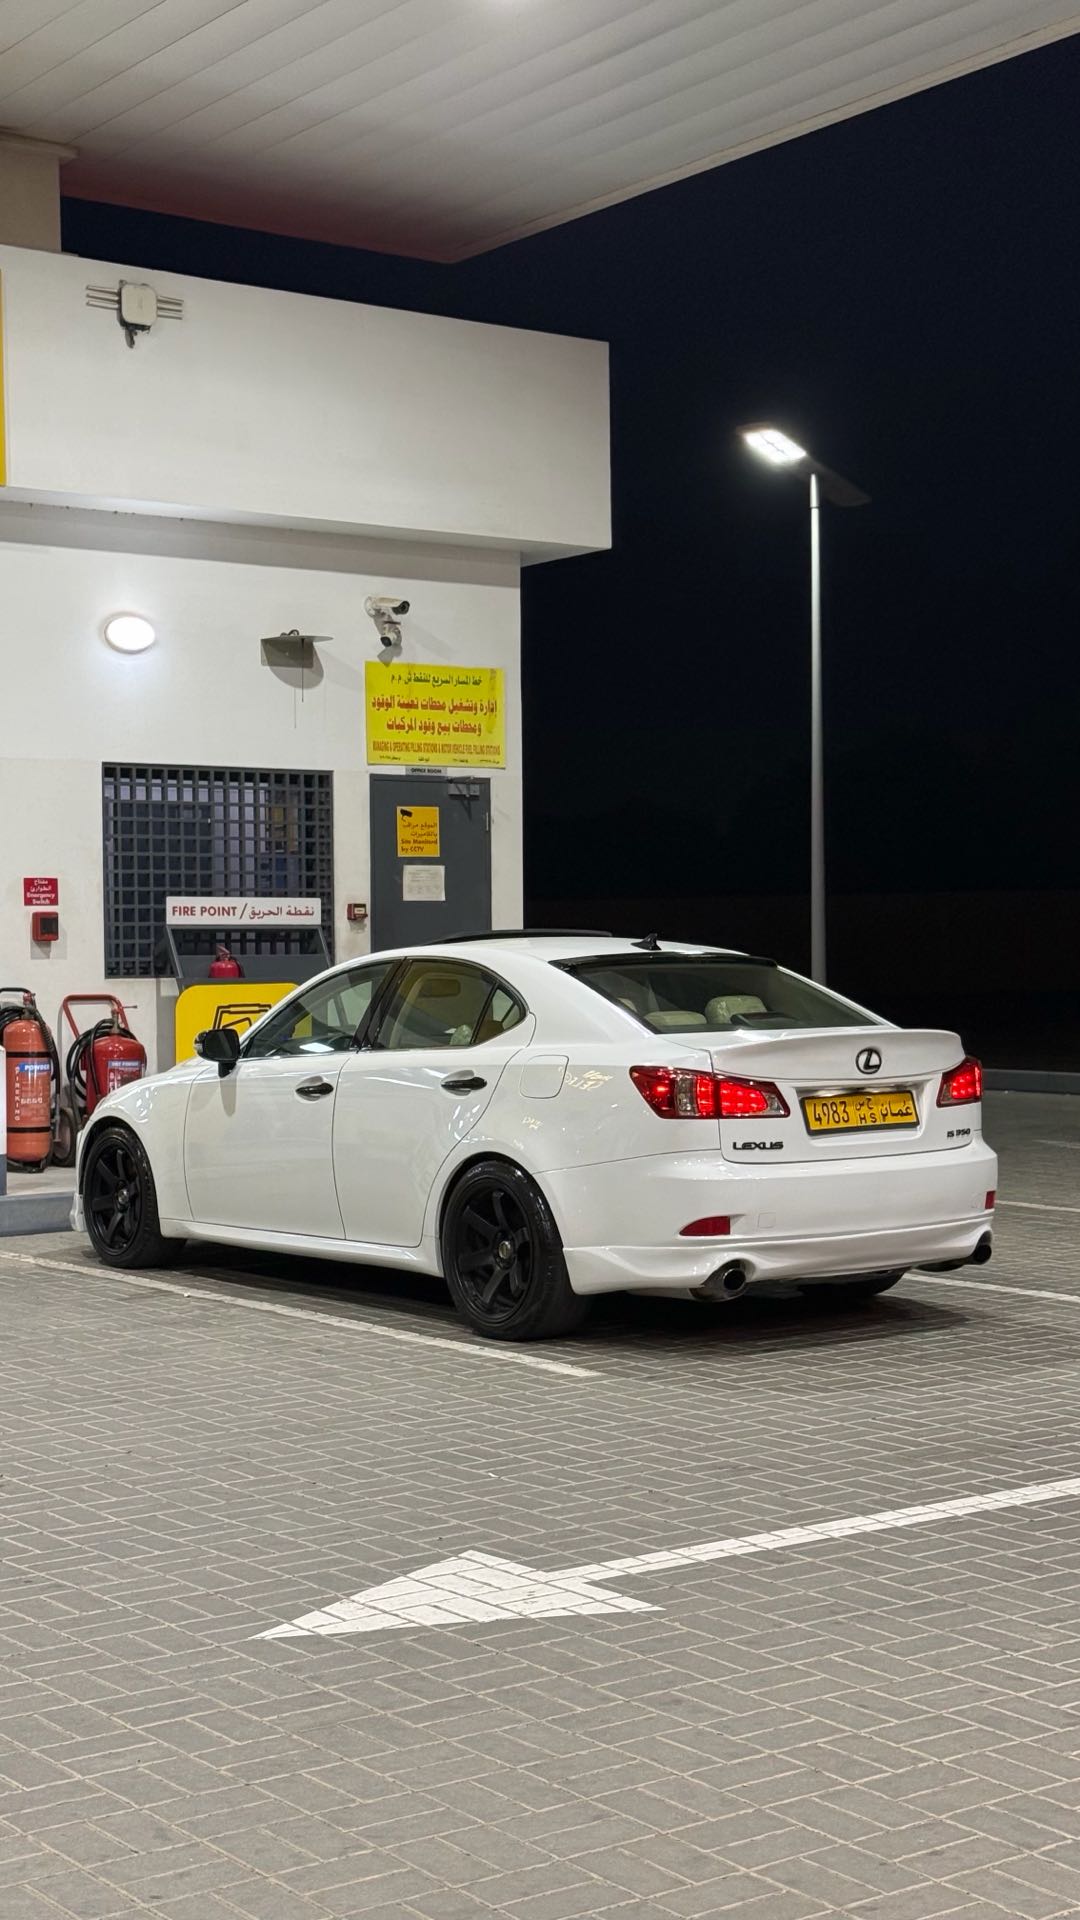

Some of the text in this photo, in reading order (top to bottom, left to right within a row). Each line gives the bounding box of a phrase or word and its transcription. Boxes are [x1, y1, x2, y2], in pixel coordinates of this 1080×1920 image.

[432, 674, 454, 688] السريع
[454, 674, 471, 687] المسار
[372, 694, 395, 711] الوقود
[421, 696, 446, 711] محطات
[386, 716, 417, 734] المركبات
[452, 719, 482, 737] ومحطات
[26, 892, 56, 900] Emergency
[172, 906, 196, 917] FIRE
[200, 906, 237, 917] POINT
[249, 905, 315, 919] نقطة الحريق
[813, 1100, 850, 1125] 4983
[732, 1141, 784, 1151] LEXUS
